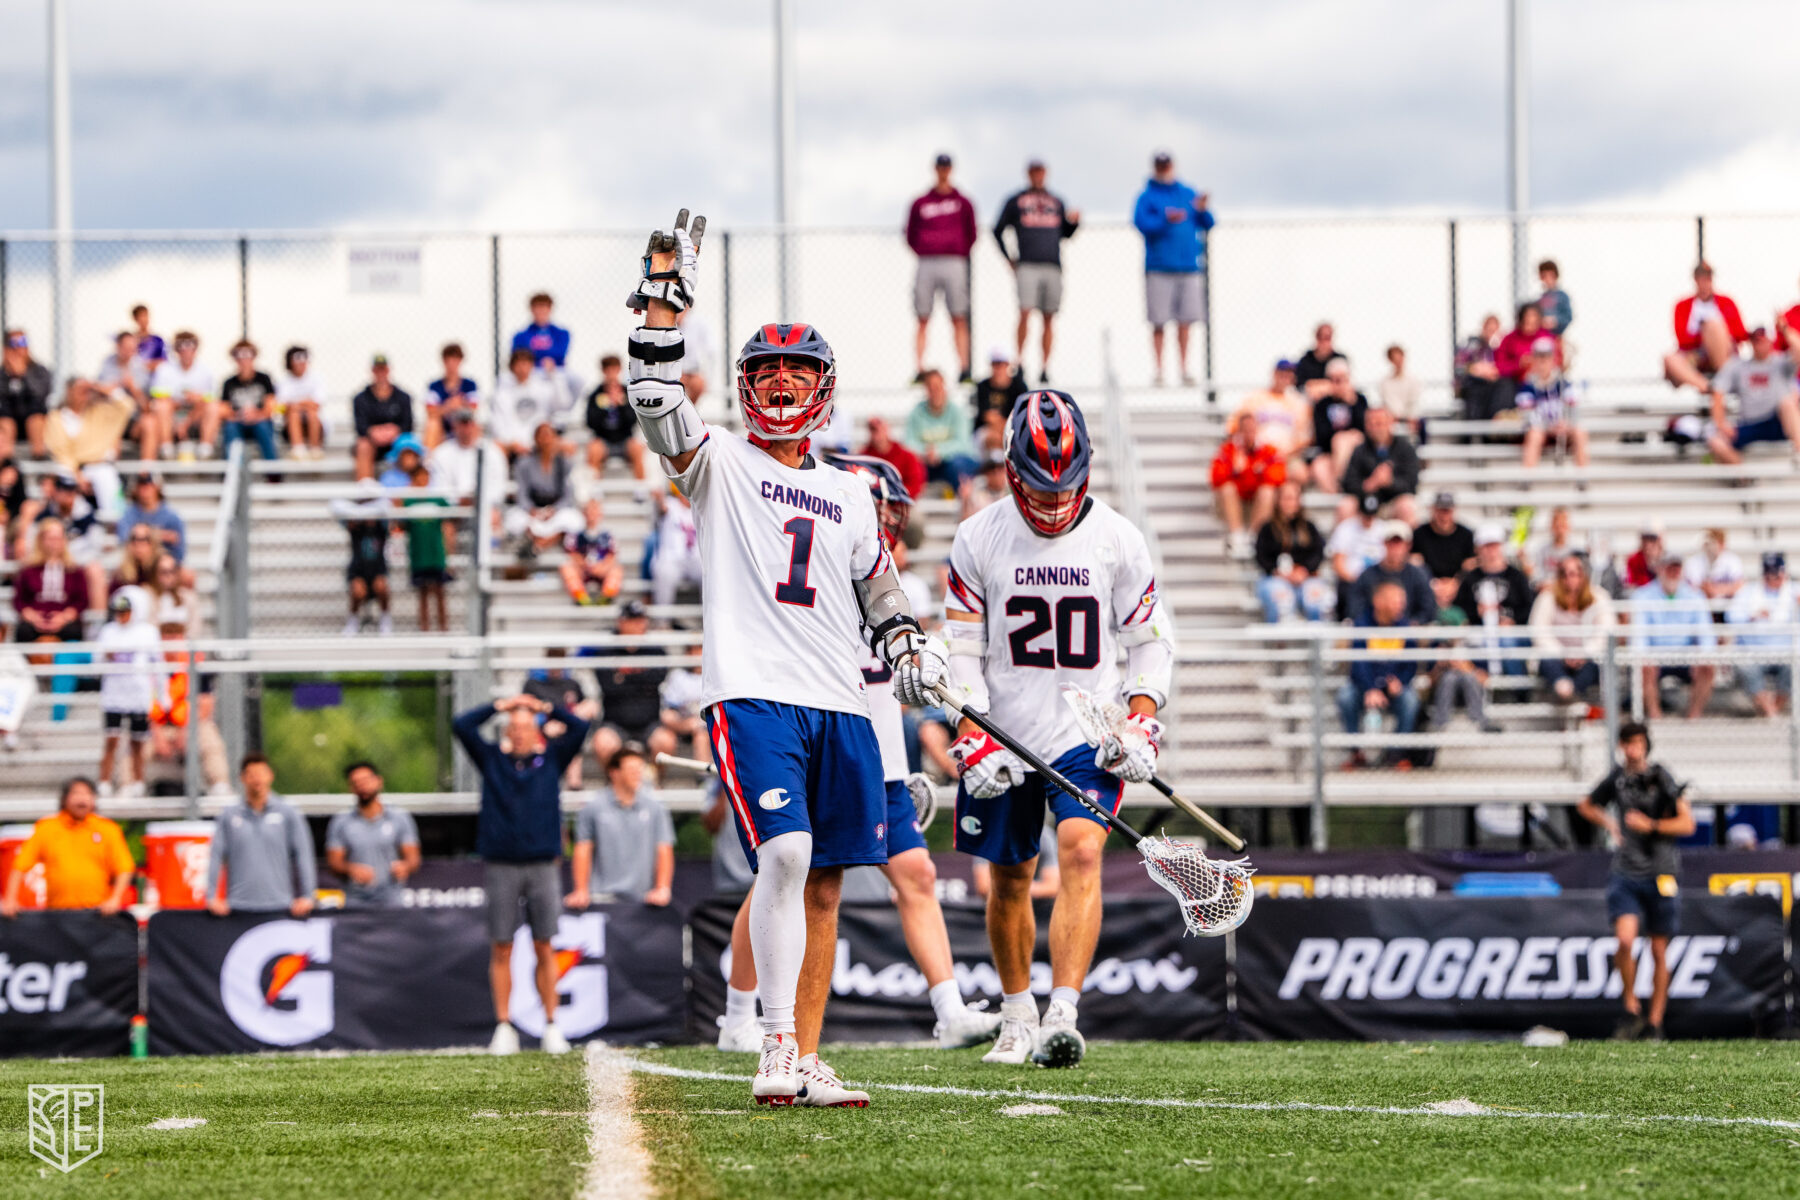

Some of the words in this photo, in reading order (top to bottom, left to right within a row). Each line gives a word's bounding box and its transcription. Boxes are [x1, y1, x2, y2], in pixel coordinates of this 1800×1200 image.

[761, 480, 842, 524] CANNONS
[775, 516, 817, 608] 1
[1015, 566, 1090, 586] CANNONS
[1005, 595, 1101, 670] 20
[219, 917, 336, 1047] G
